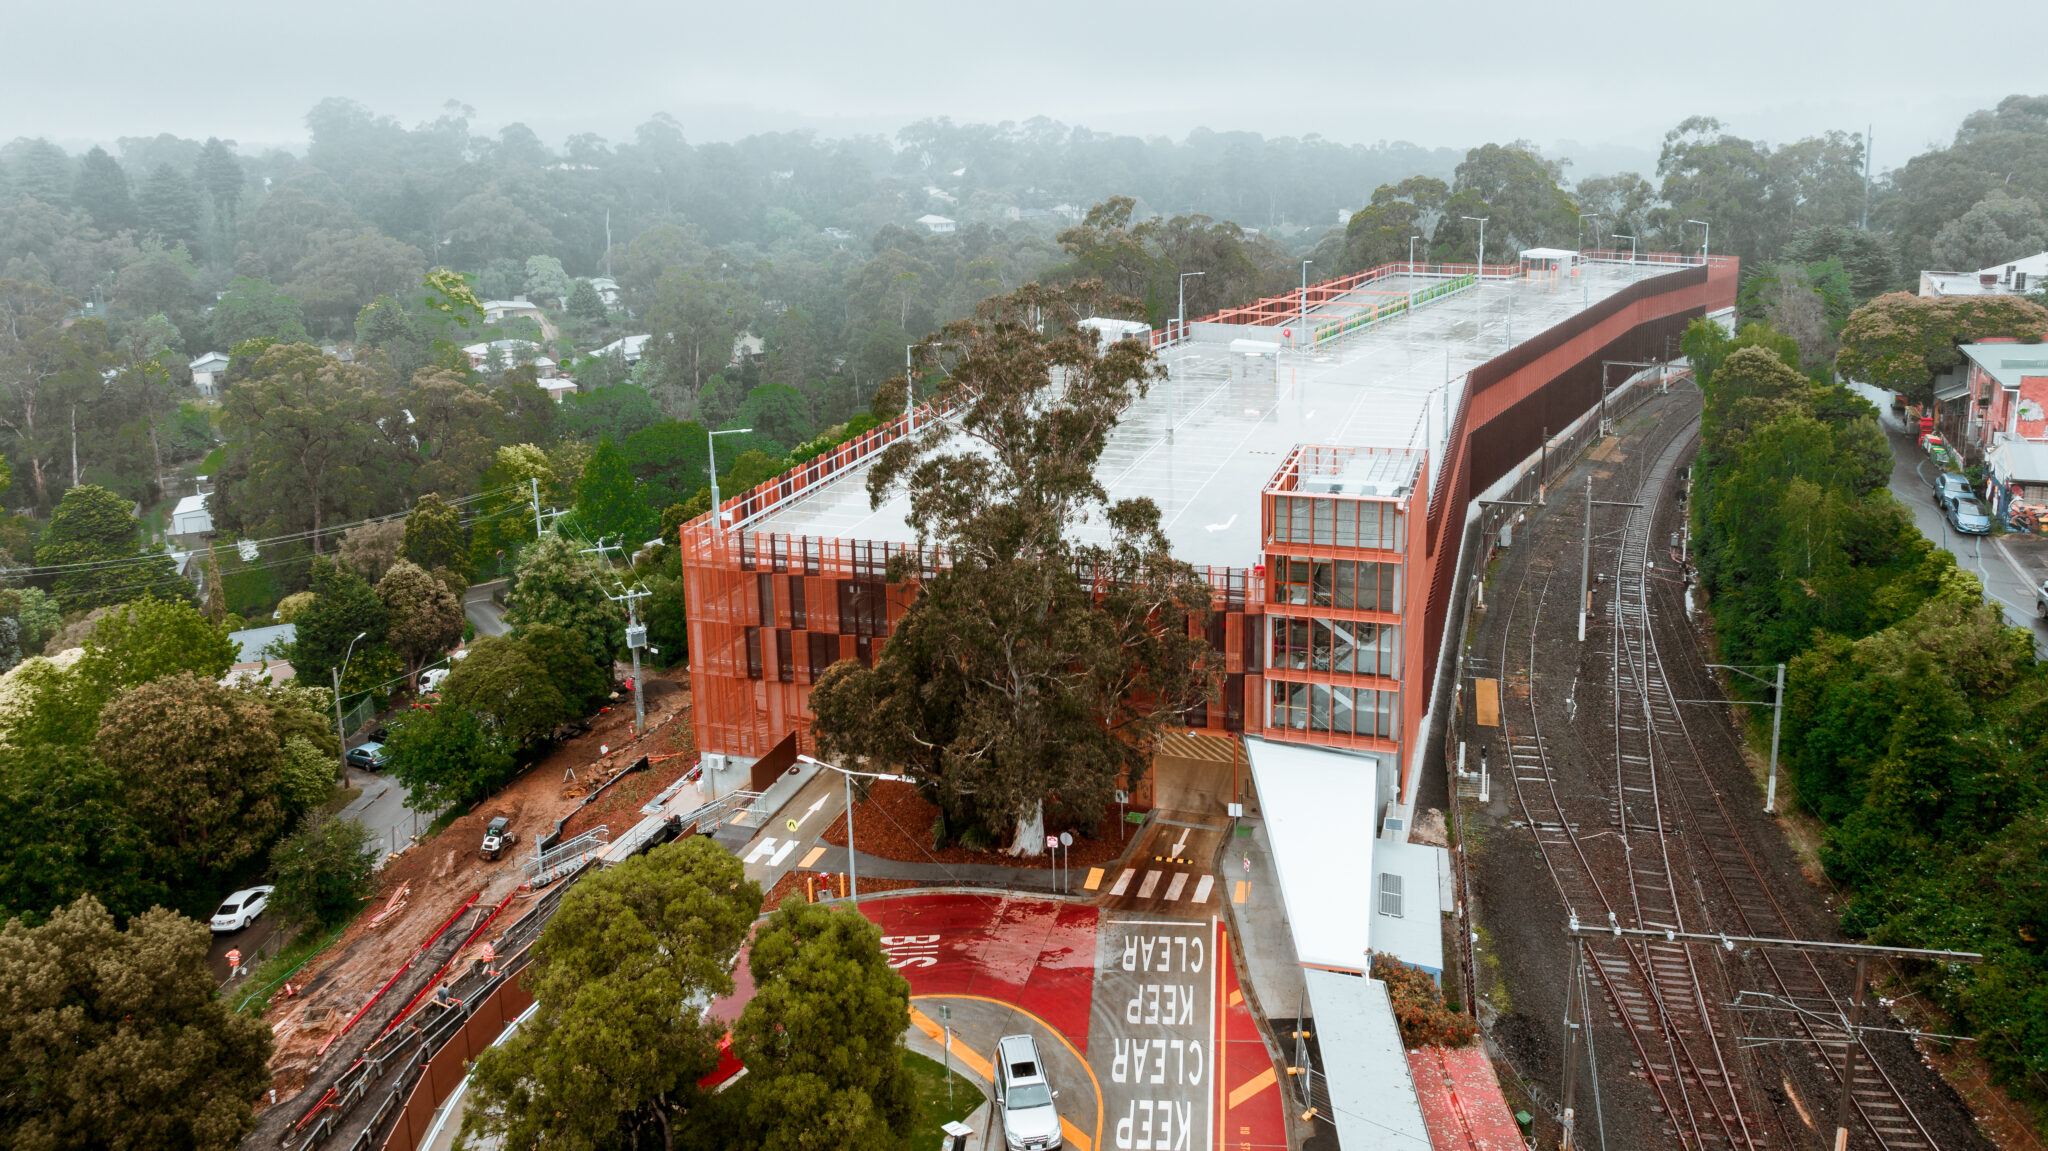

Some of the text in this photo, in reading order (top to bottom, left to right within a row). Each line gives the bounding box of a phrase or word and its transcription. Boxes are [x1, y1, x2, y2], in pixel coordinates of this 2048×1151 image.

[880, 934, 940, 969] BUS
[1122, 935, 1204, 973] CLEAR
[1126, 984, 1194, 1026] KEEP
[1111, 1038, 1204, 1086] CLEAR
[1115, 1099, 1192, 1151] KEEP
[1240, 1126, 1250, 1151] NO ST
